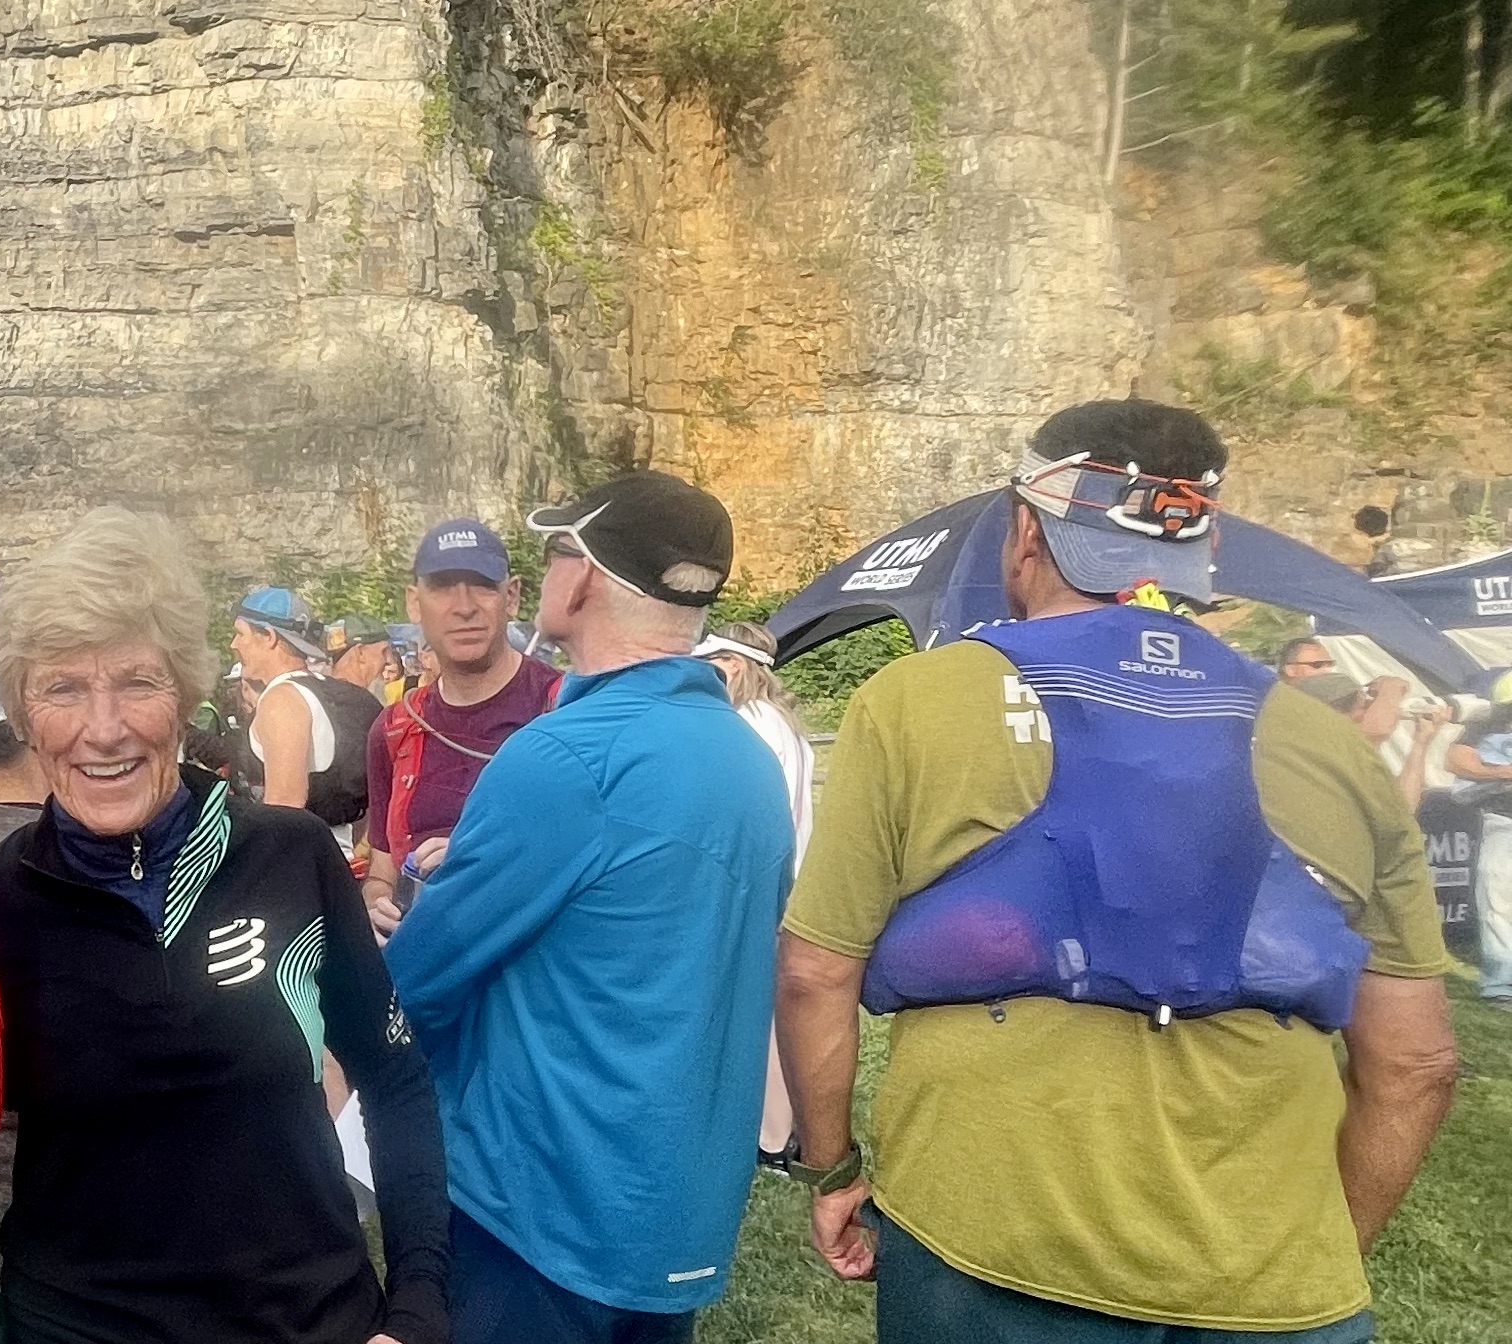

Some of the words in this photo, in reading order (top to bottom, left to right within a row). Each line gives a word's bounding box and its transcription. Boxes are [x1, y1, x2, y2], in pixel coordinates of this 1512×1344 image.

[438, 531, 477, 544] UTMB
[863, 529, 950, 570] UTMB
[1474, 577, 1512, 600] UT
[1117, 660, 1207, 680] salomon
